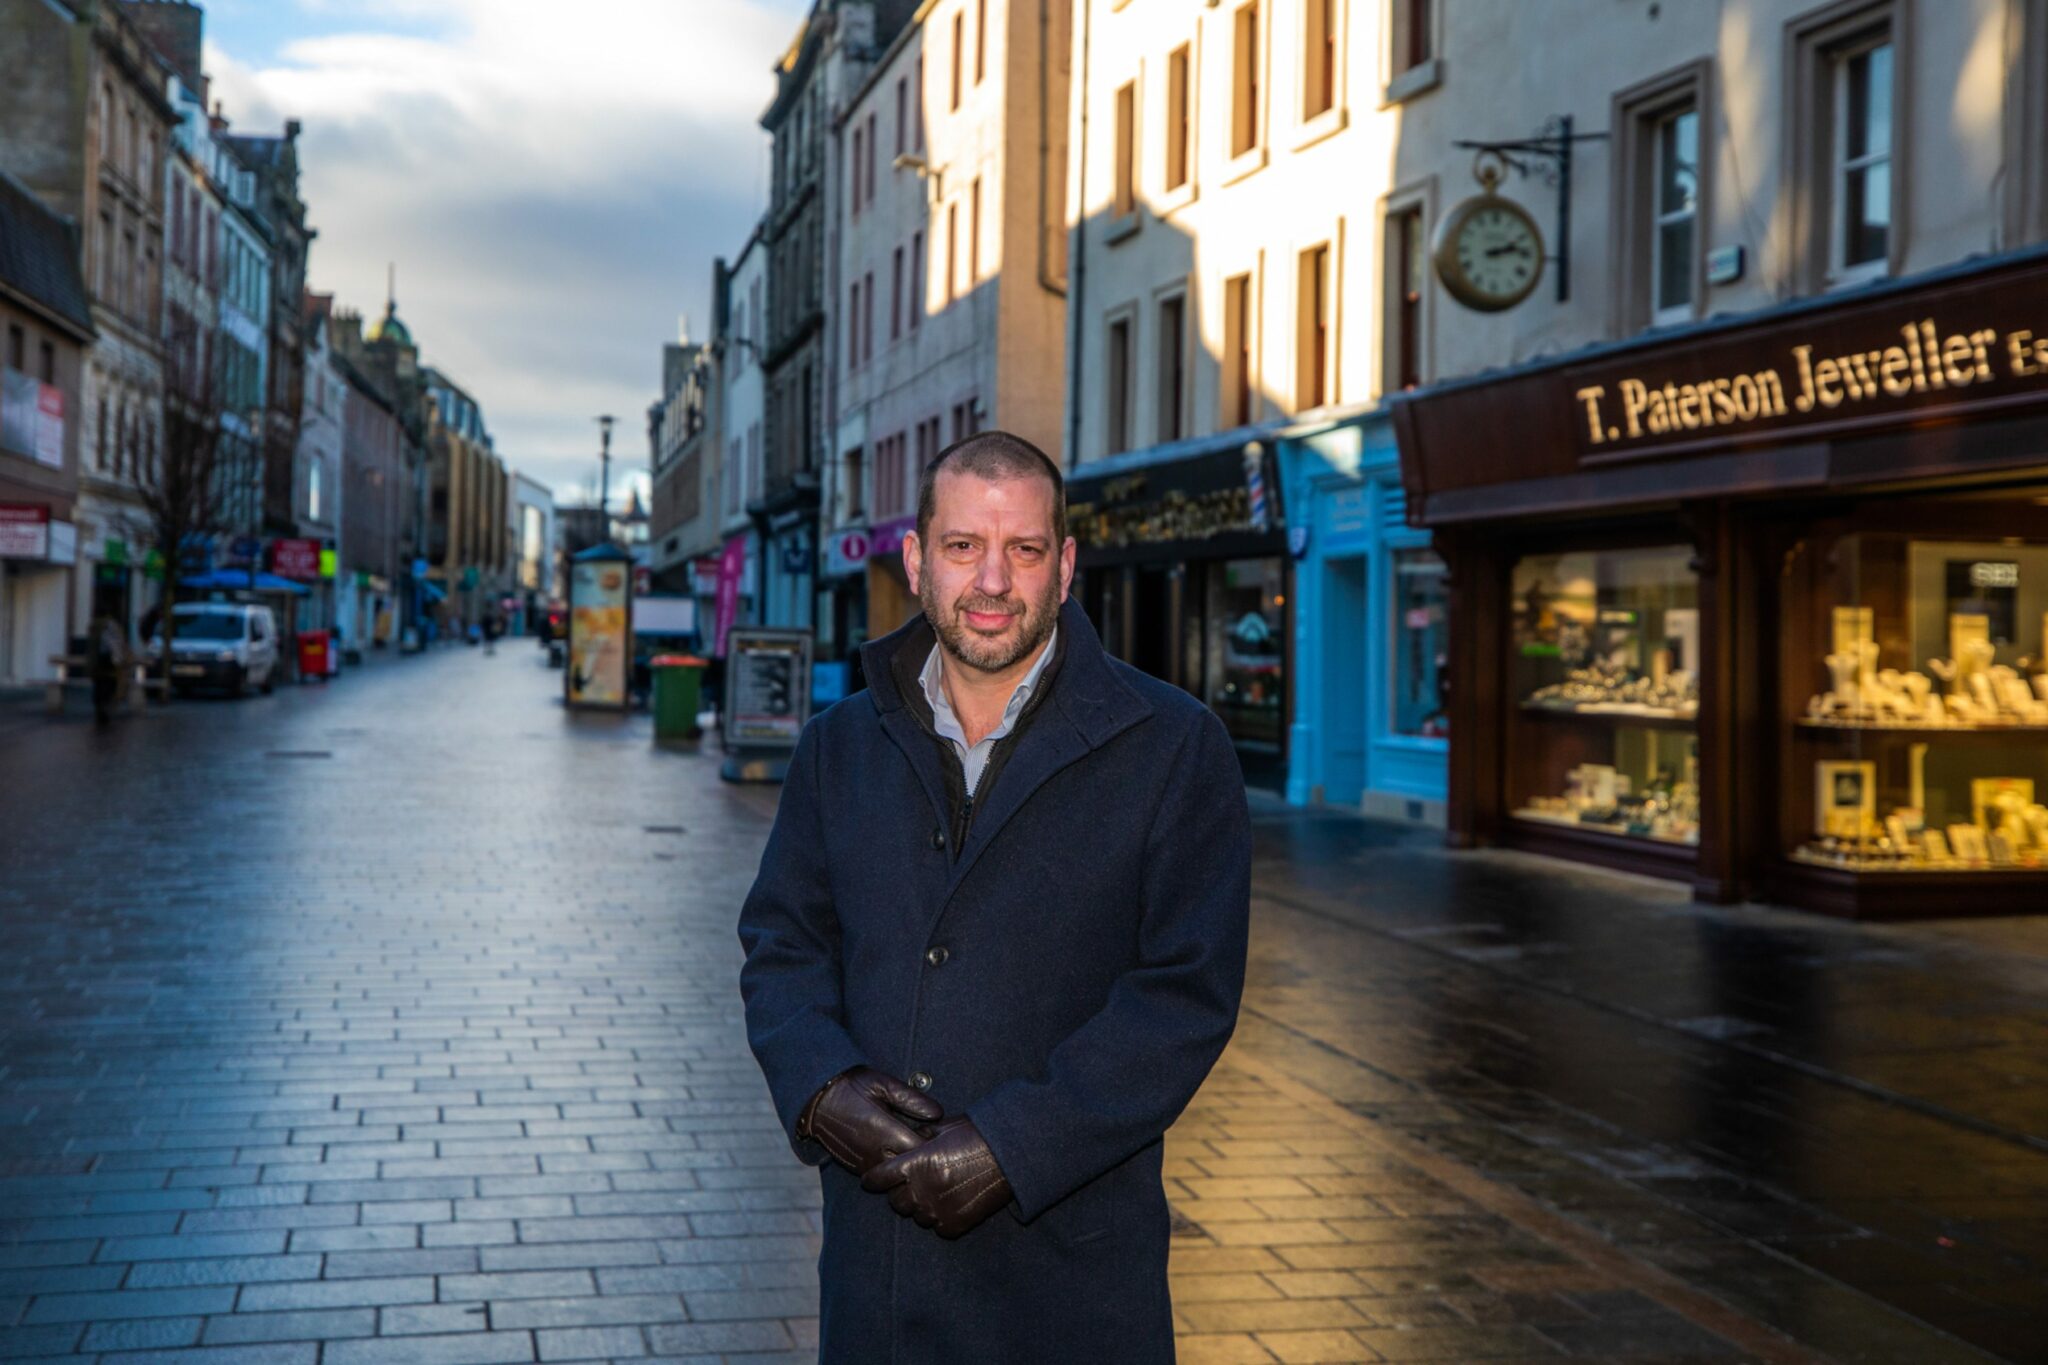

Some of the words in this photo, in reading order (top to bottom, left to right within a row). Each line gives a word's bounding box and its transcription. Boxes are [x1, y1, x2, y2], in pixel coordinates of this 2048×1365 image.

[1576, 384, 1620, 443] T.
[1618, 369, 1788, 438] Paterson
[1791, 318, 1997, 413] Jeweller
